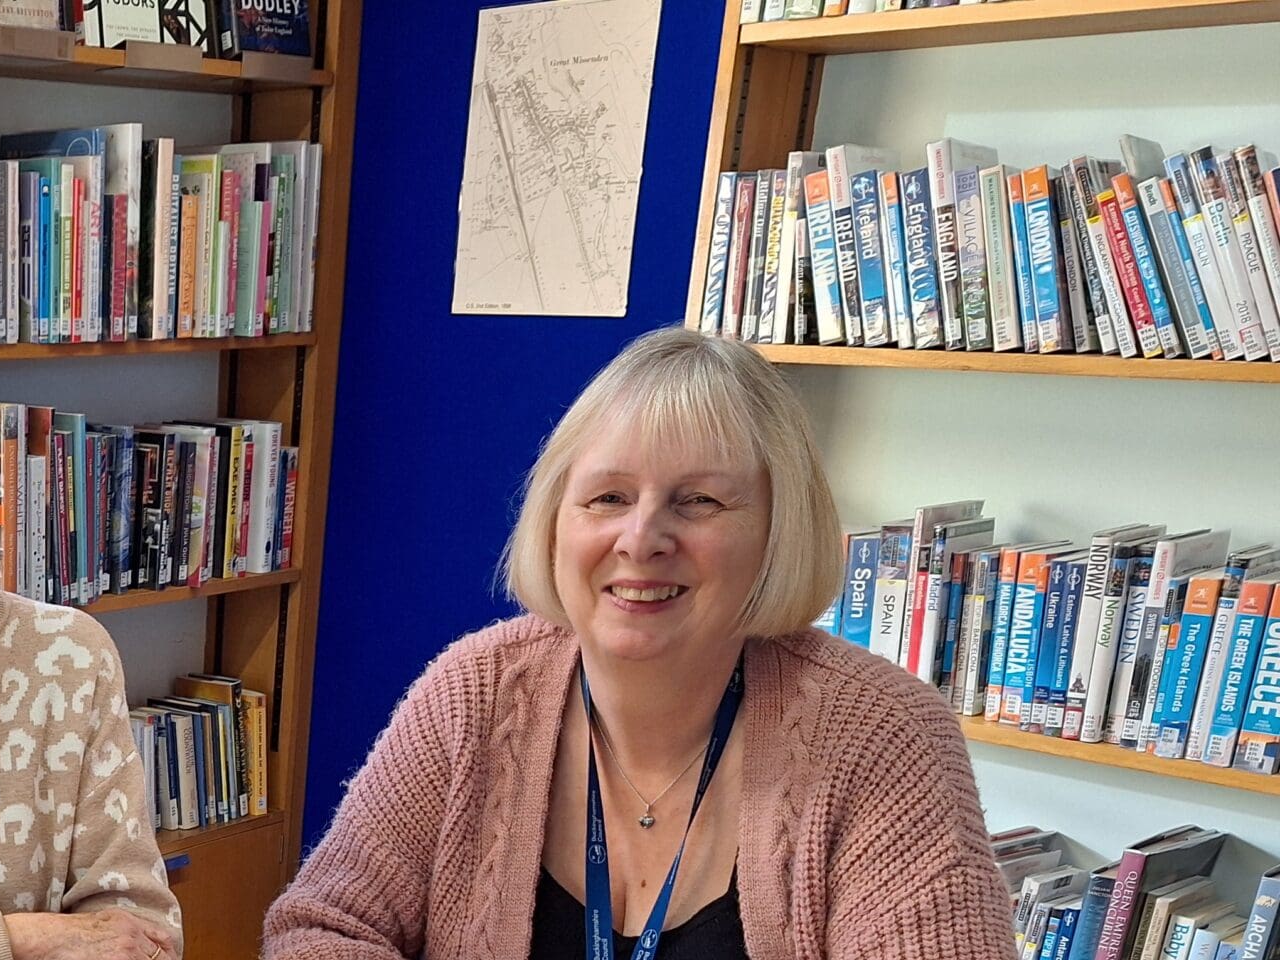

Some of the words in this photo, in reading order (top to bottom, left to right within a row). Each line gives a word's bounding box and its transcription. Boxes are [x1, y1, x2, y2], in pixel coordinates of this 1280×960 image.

[241, 0, 300, 15] DUDLEY
[550, 58, 570, 67] Great
[572, 54, 609, 66] Missenden
[1143, 183, 1157, 207] Bradt
[807, 205, 838, 286] IRELAND
[833, 214, 856, 282] IRELAND
[857, 204, 877, 259] Ireland
[907, 203, 930, 270] England
[938, 213, 959, 282] ENGLAND
[962, 210, 978, 264] VILLAGE
[1027, 200, 1053, 267] LONDON
[1190, 231, 1211, 268] BERLIN
[1066, 255, 1078, 292] LONDON
[1118, 240, 1132, 262] North
[1125, 264, 1139, 287] Devon
[1206, 201, 1234, 248] Berlin
[1234, 300, 1252, 324] 2018
[1240, 232, 1261, 274] PRAGUE
[230, 485, 238, 516] MEN
[282, 479, 297, 536] WENGER
[850, 567, 872, 619] Spain
[1084, 544, 1110, 601] NORWAY
[879, 594, 896, 635] SPAIN
[926, 576, 941, 612] Madrid
[997, 584, 1011, 626] MALLORCA
[1045, 591, 1061, 629] Ukraine
[1062, 594, 1076, 624] Estonia,
[1060, 624, 1071, 648] Latvia
[1097, 599, 1121, 649] Norway
[1119, 591, 1146, 665] SWEDEN
[1143, 613, 1158, 640] SWEDEN
[1187, 622, 1201, 642] The
[1210, 614, 1229, 656] GREECE
[1238, 618, 1255, 637] THE
[957, 626, 970, 673] BARCELONA
[968, 627, 981, 674] BARCELONA
[991, 635, 1005, 673] MENORCA
[1180, 644, 1197, 675] Greek
[1230, 638, 1250, 670] GREEK
[1024, 658, 1034, 689] LISBON
[1055, 655, 1067, 689] Lithuania
[1220, 670, 1242, 712] ISLANDS
[1171, 676, 1188, 713] Islands
[1118, 871, 1138, 913] QUEEN,
[1097, 881, 1125, 953] CONCUBINE
[1162, 924, 1190, 960] Baby
